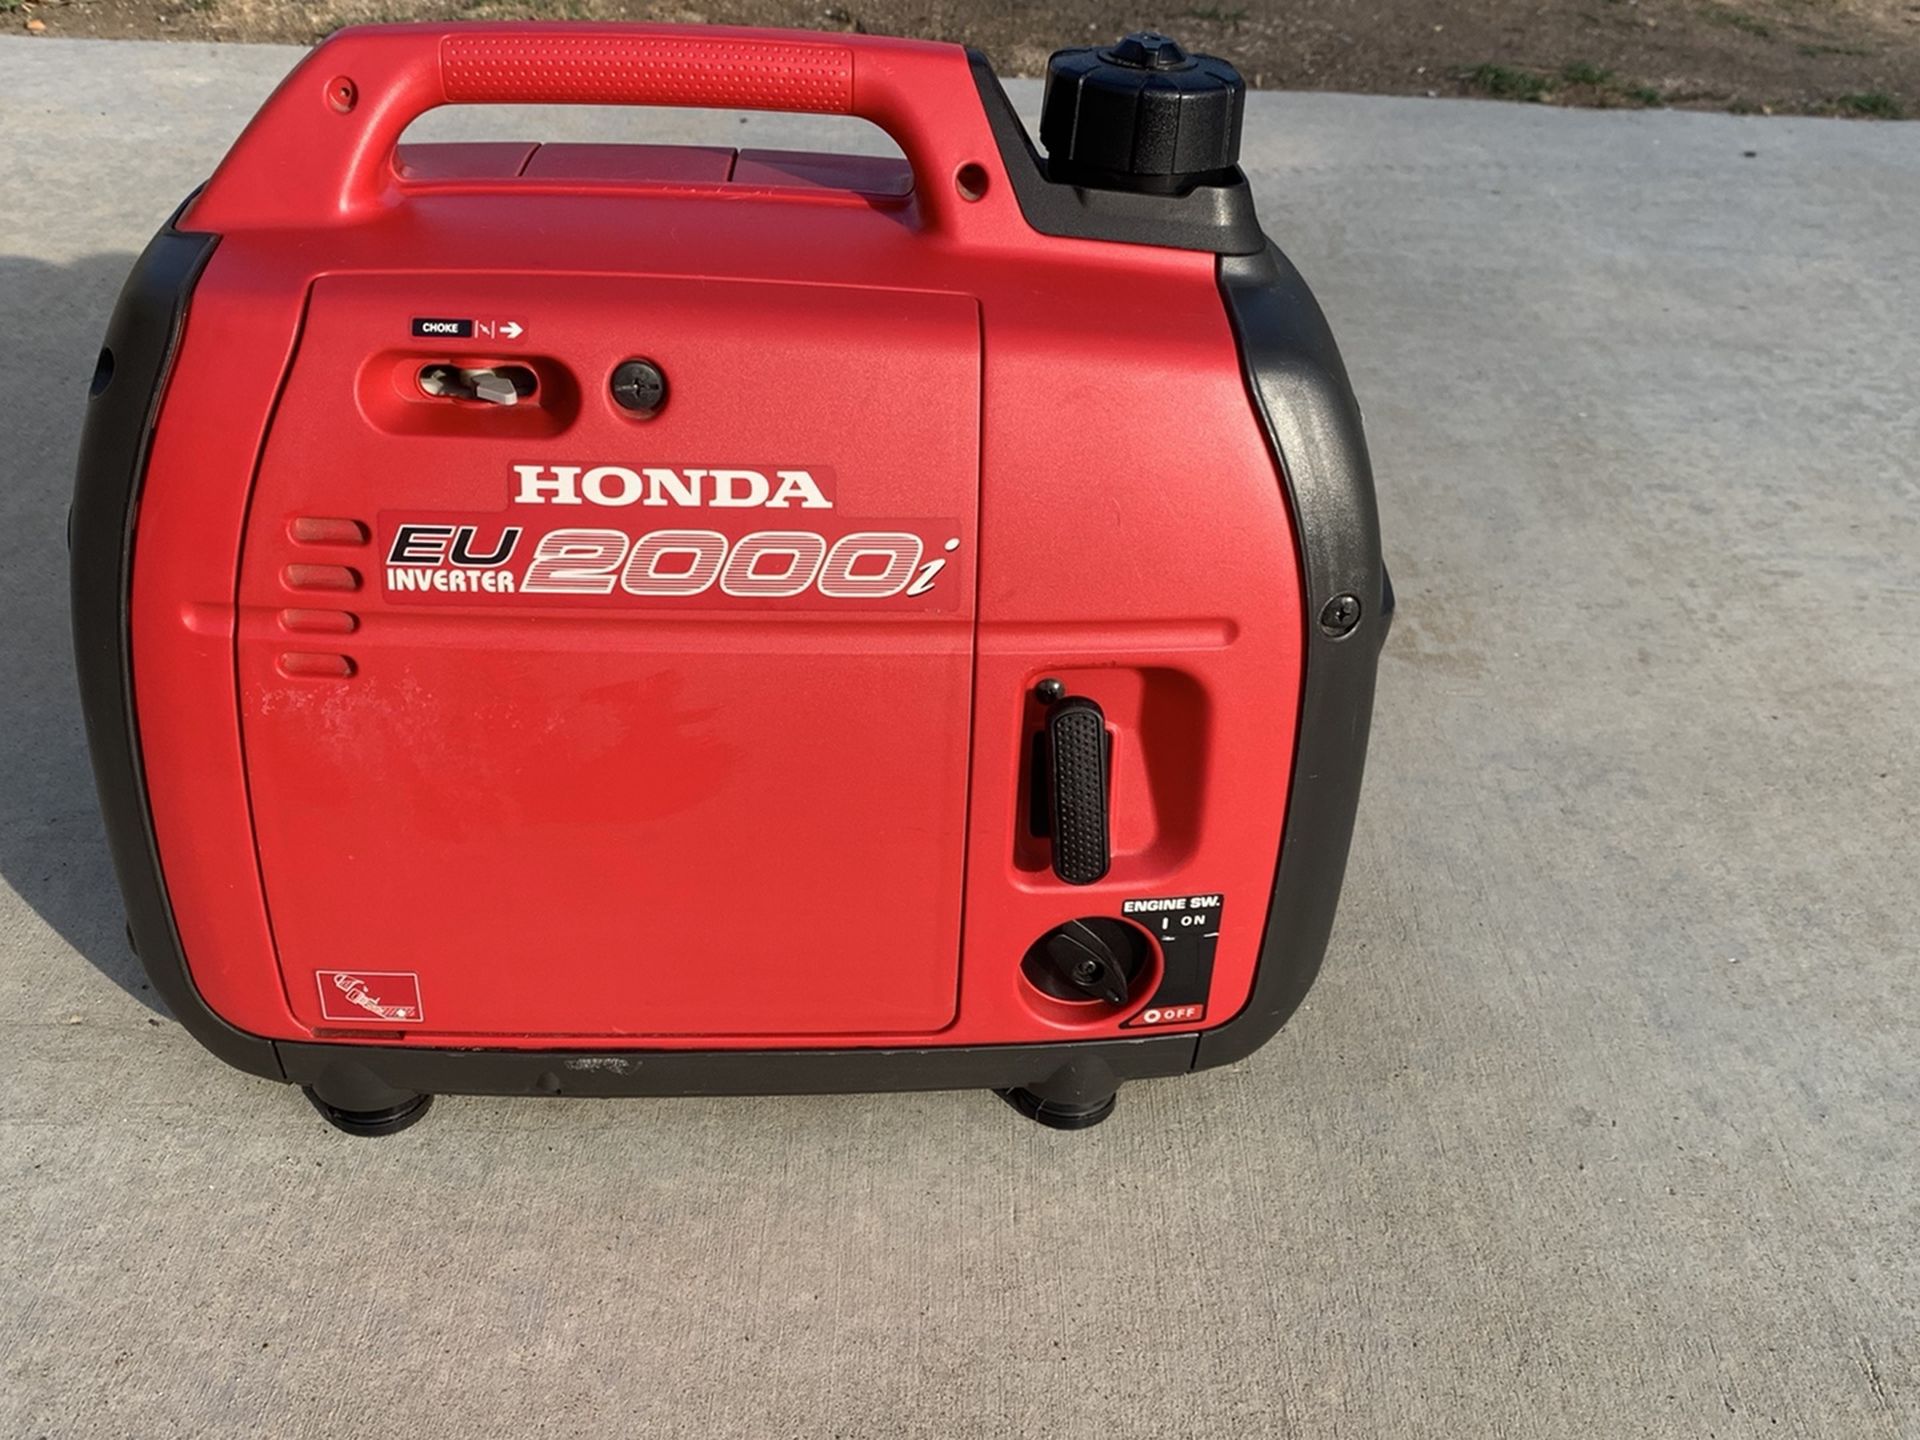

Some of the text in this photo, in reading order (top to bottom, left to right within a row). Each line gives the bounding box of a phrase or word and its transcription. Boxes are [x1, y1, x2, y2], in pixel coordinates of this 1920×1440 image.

[422, 322, 459, 334] CHOKE
[514, 465, 833, 509] HONDA
[386, 525, 523, 565] EU
[387, 568, 515, 593] INVERTER
[1124, 896, 1220, 913] ENGINE SW.
[1181, 915, 1205, 927] ON
[1164, 1007, 1195, 1020] OFF
